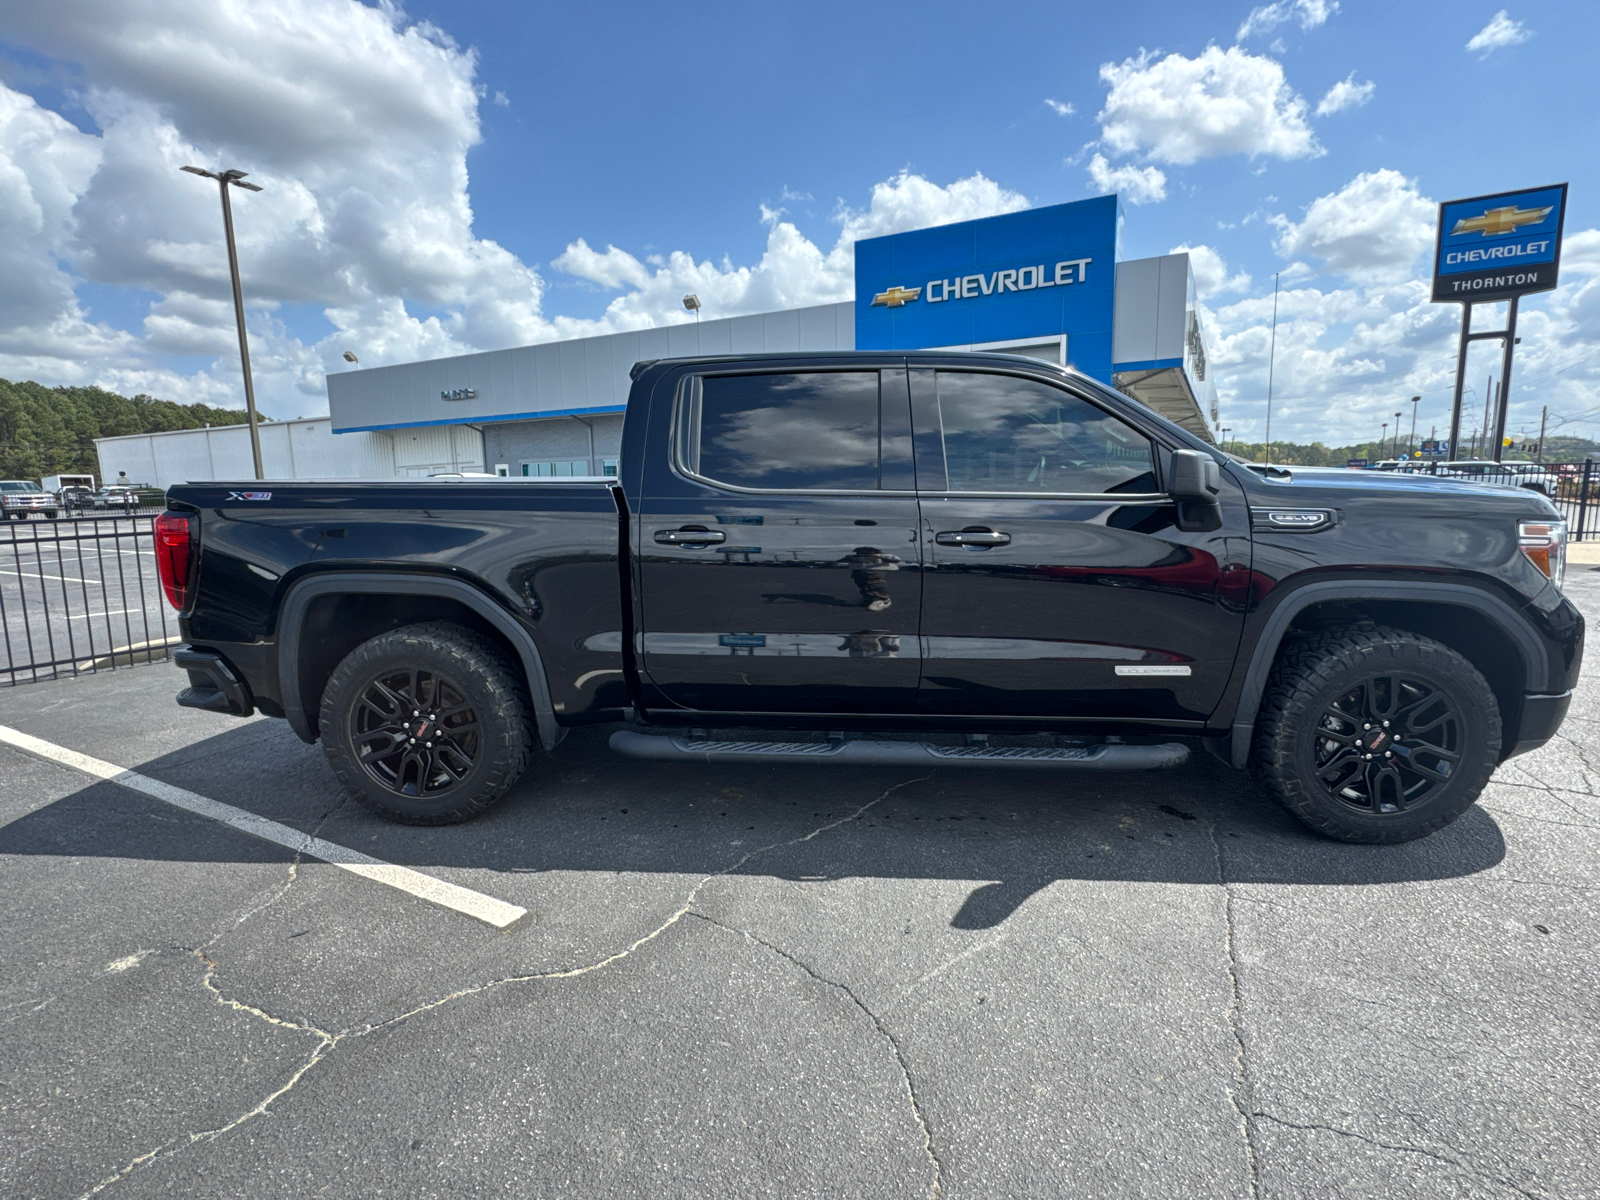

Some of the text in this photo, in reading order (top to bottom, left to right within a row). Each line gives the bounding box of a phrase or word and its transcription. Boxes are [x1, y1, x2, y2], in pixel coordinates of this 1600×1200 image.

[1446, 240, 1550, 265] CHEVROLET
[926, 257, 1093, 303] CHEVROLET
[1452, 272, 1538, 292] THORNTON
